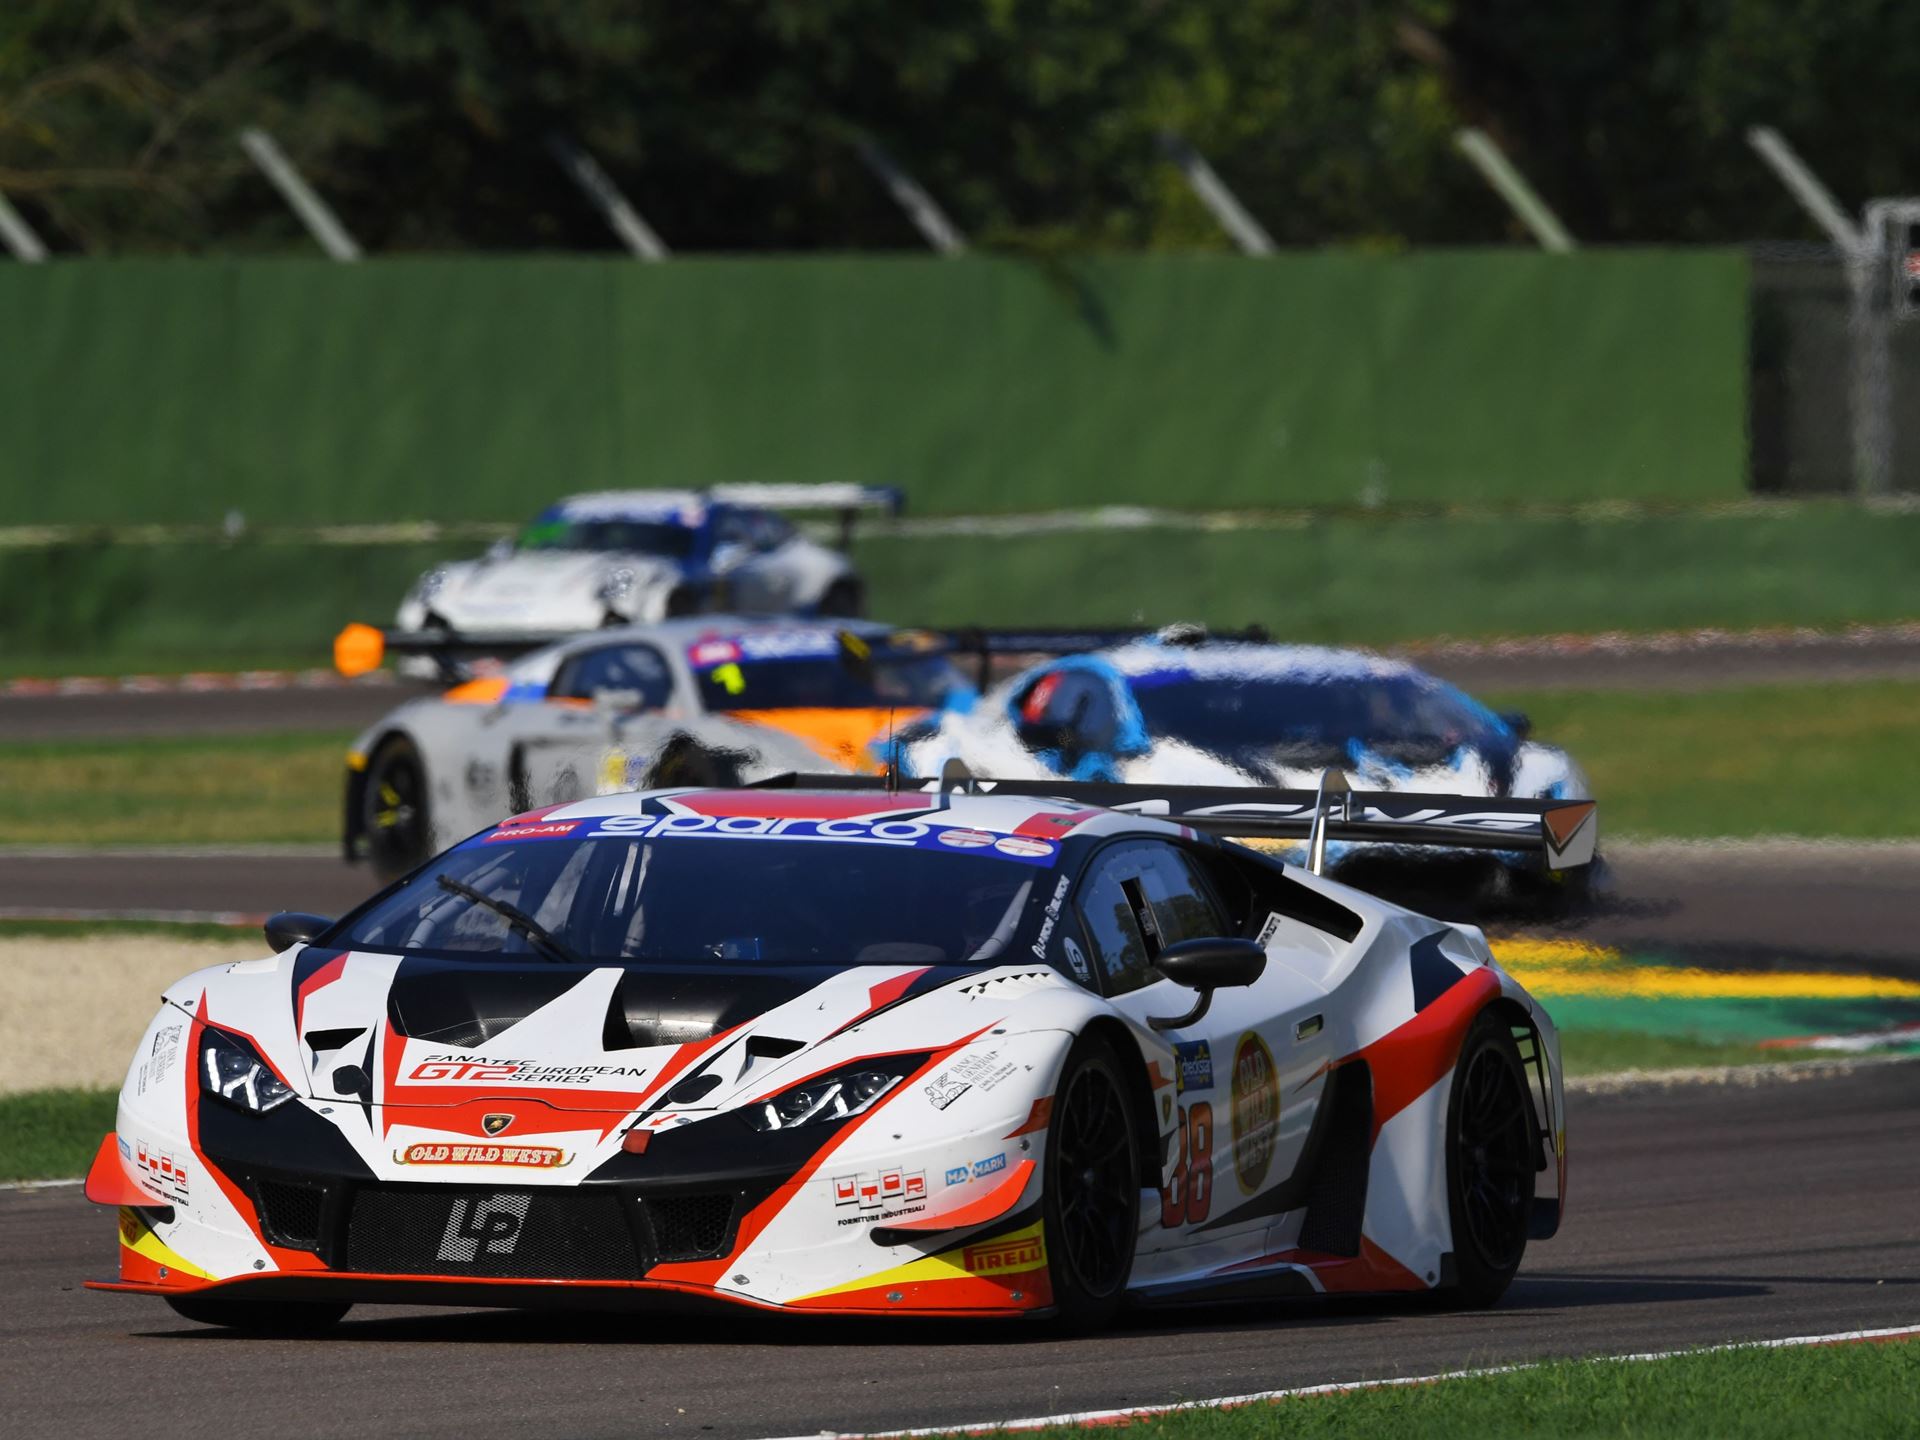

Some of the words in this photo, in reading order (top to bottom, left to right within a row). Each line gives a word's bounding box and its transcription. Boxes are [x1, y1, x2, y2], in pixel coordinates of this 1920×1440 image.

[489, 824, 576, 839] PRO-AM
[598, 814, 930, 842] sparco
[423, 1055, 536, 1066] FANATEC
[408, 1062, 520, 1081] GT2
[516, 1065, 648, 1078] EUROPEAN
[506, 1073, 594, 1084] SERIES
[410, 1146, 450, 1162] OLD
[451, 1146, 501, 1163] WILD
[501, 1148, 559, 1165] WEST
[946, 1154, 1005, 1185] MAXMARK
[837, 1213, 880, 1227] FORNITURE
[881, 1205, 926, 1220] INDUSTRIALI
[963, 1235, 1043, 1273] PIRELLI
